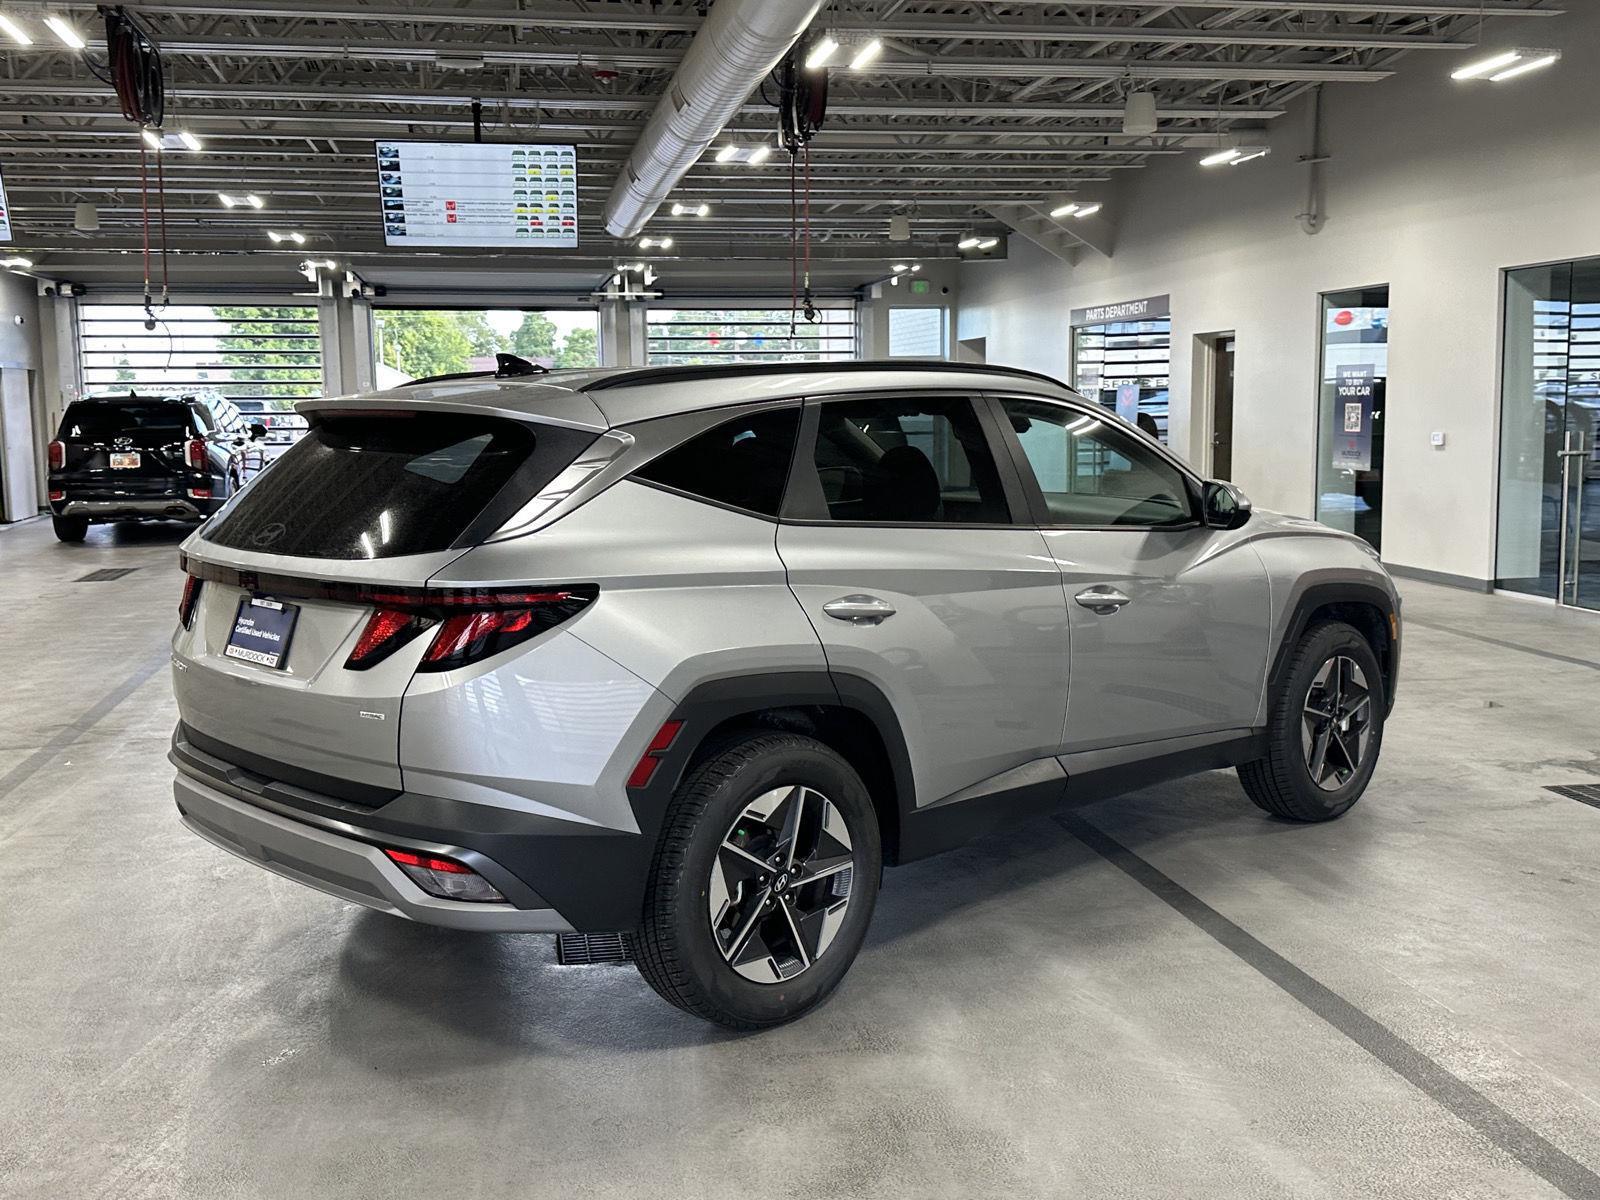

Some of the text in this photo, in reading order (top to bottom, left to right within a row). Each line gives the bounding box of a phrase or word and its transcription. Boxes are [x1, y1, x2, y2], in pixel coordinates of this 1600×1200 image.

[1086, 301, 1148, 321] PARTS DEPARTMENT
[1338, 386, 1371, 396] YOUR CAR
[238, 616, 255, 626] Hyundai
[235, 625, 280, 641] Certified Used Vehicles
[238, 649, 265, 662] MURDOCK
